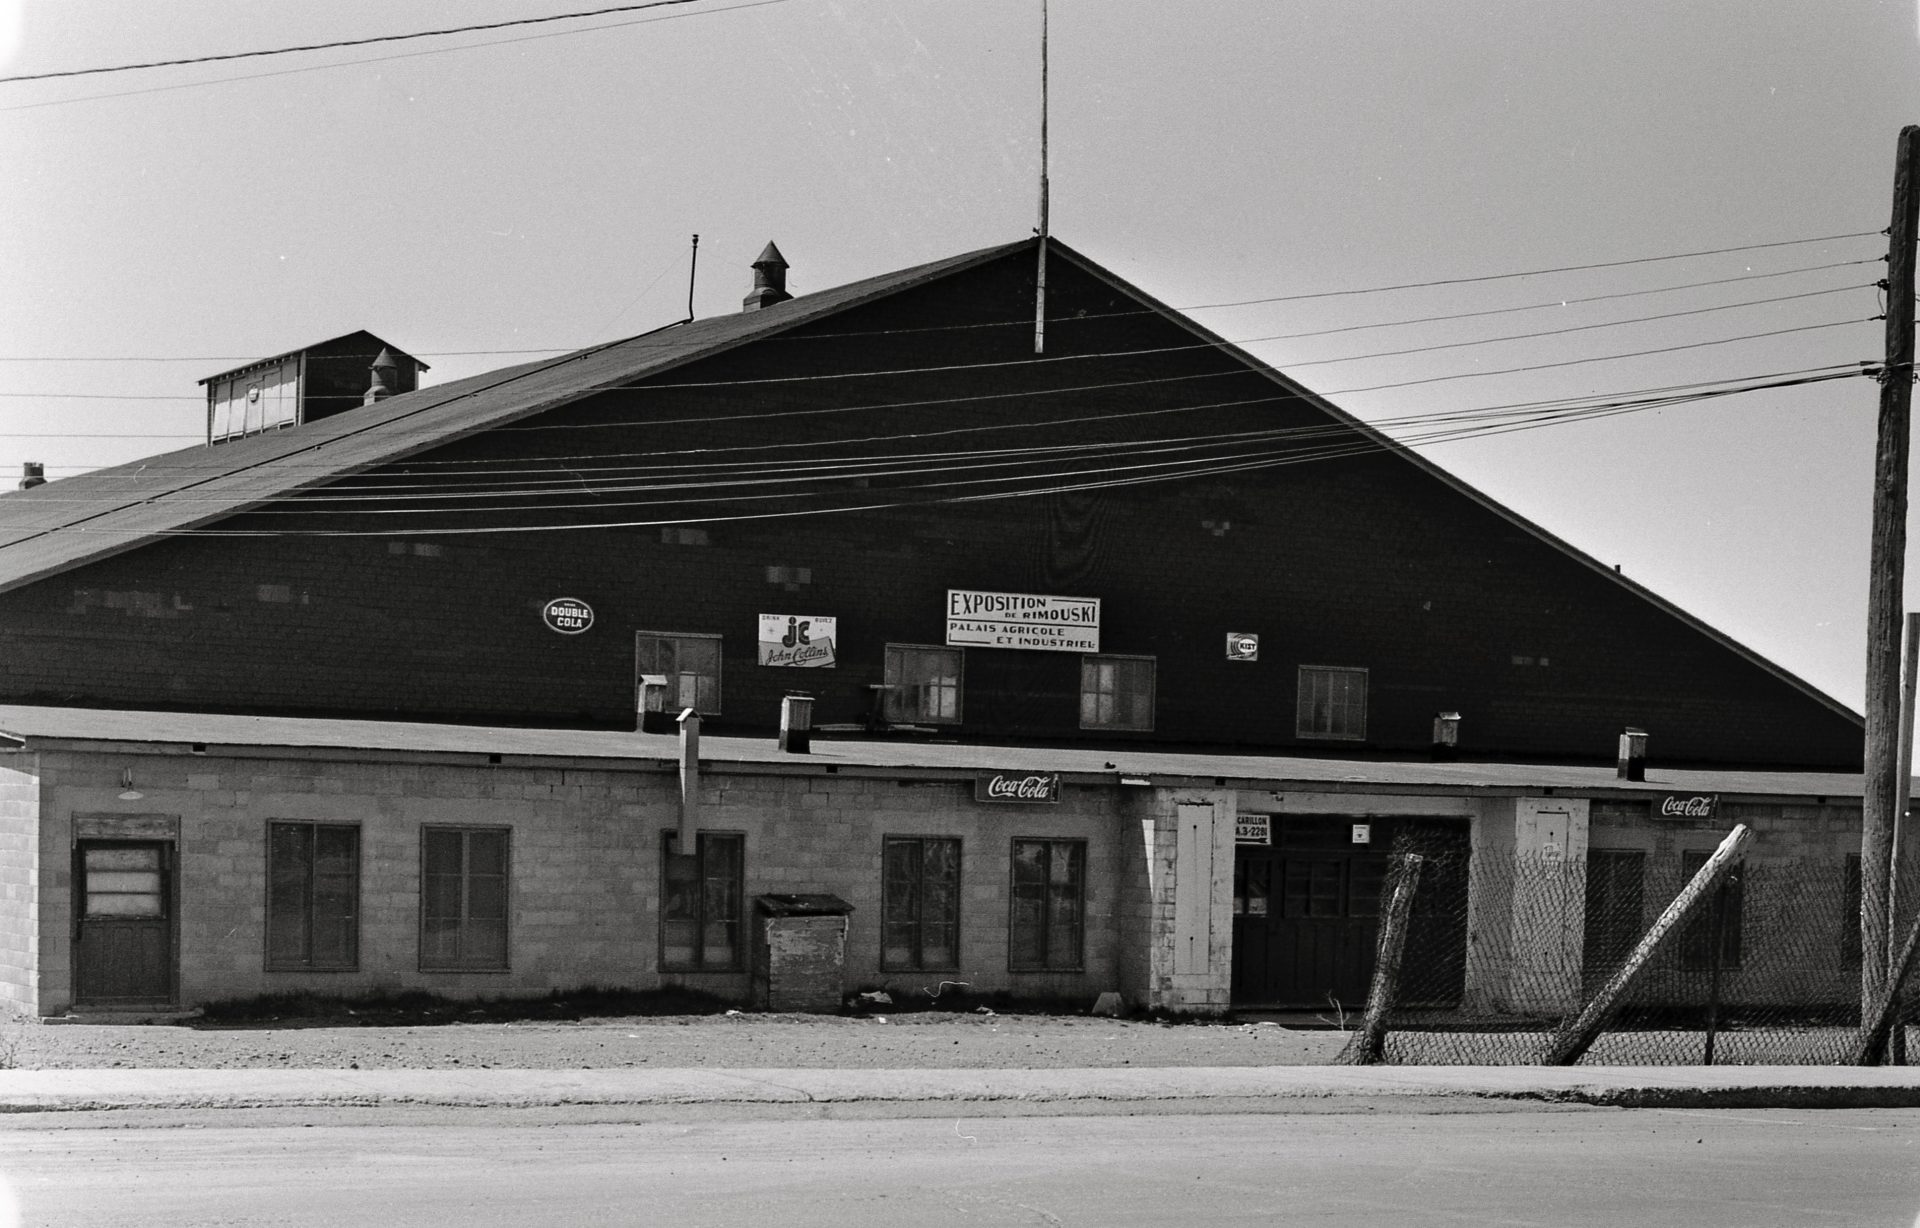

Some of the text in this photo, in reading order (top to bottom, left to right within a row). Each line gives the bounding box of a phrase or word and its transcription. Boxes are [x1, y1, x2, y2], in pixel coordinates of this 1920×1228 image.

[950, 593, 1047, 615] EXPOSITION
[551, 606, 589, 618] DOUBLE
[1023, 606, 1096, 623] RIMOUSKI
[557, 617, 582, 628] COLA
[950, 623, 1065, 636] PALAIS AGRICOLE
[996, 636, 1095, 649] ET INDUSTRIEL
[765, 646, 829, 666] John Collins
[988, 775, 1051, 798] Coca-Cola
[1661, 796, 1712, 816] Coca-Cola
[1237, 816, 1268, 825] CARILLON
